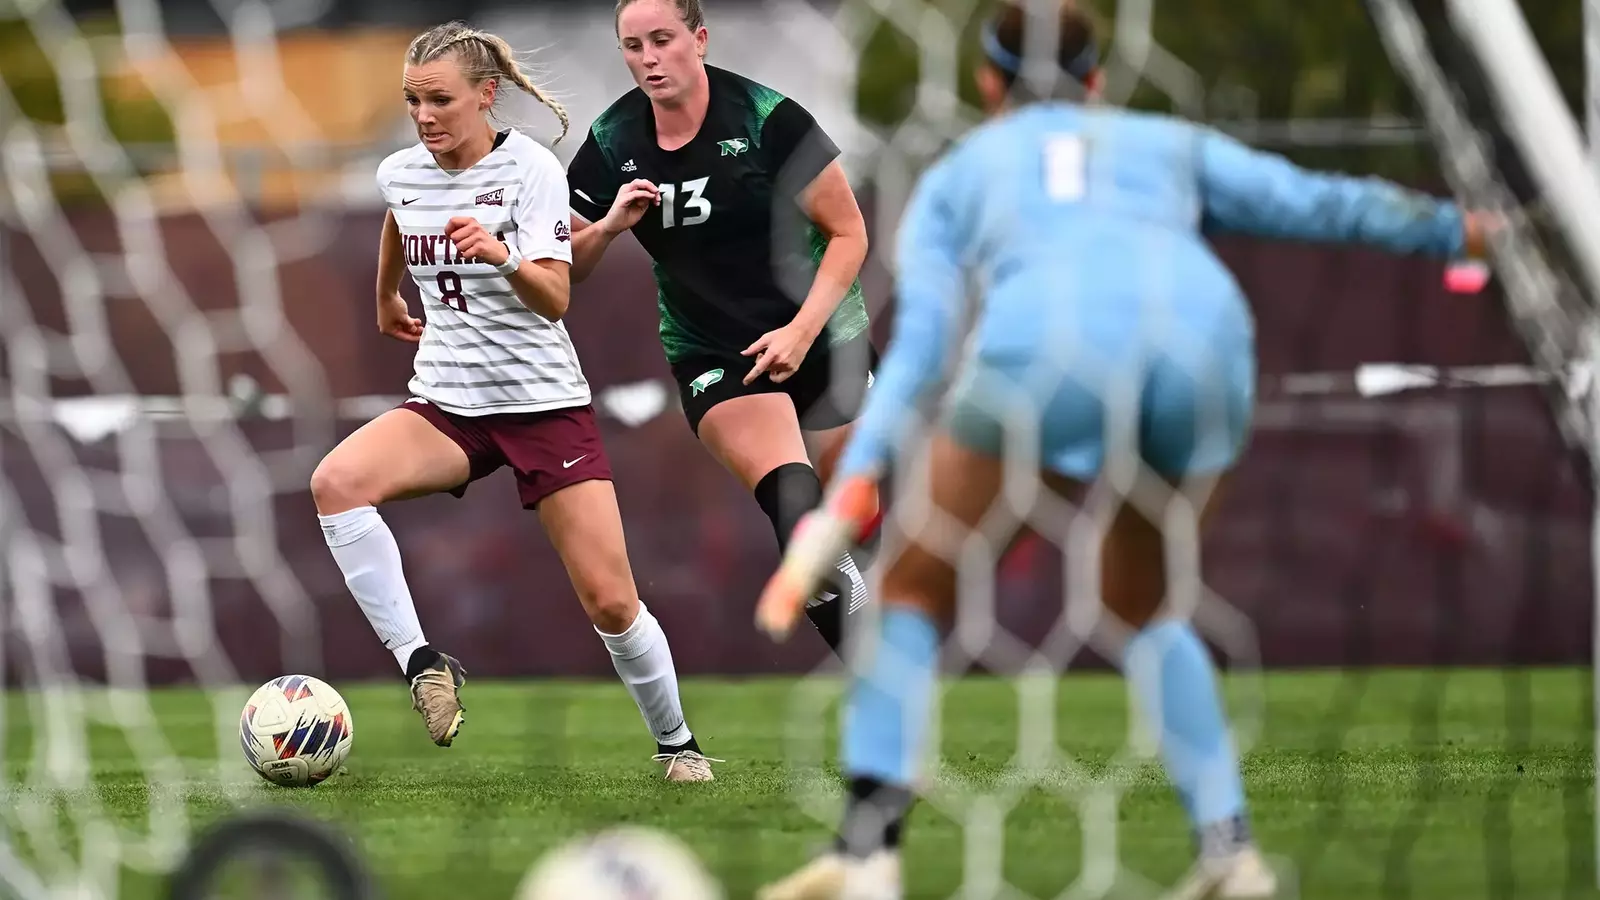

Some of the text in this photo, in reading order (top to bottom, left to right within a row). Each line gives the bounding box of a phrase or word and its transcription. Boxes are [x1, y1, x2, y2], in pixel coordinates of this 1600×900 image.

[658, 176, 711, 229] 13
[436, 271, 468, 313] 8
[271, 761, 290, 769] NCAA
